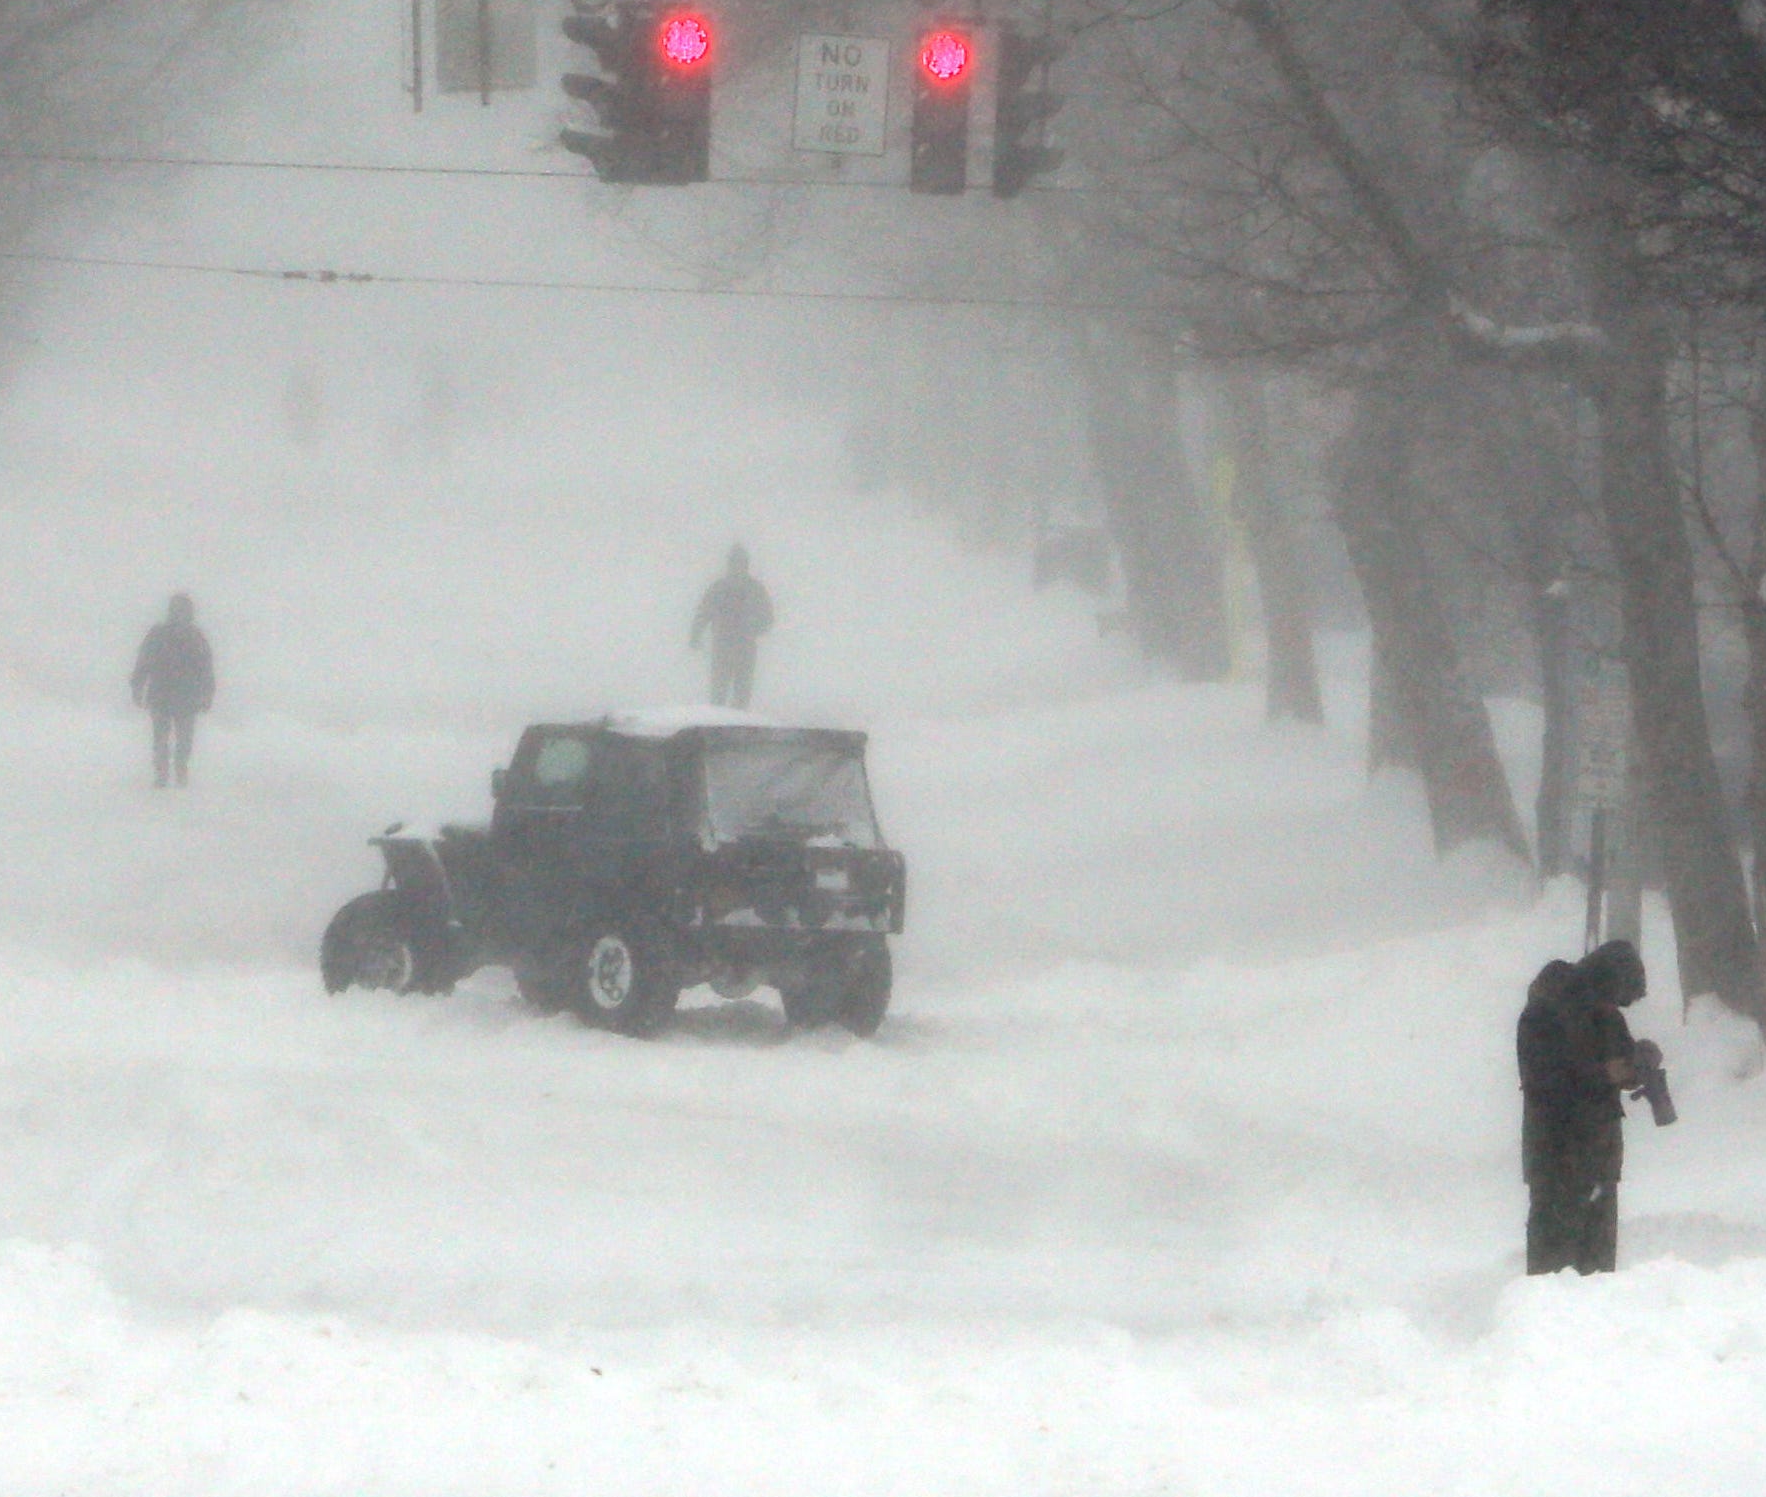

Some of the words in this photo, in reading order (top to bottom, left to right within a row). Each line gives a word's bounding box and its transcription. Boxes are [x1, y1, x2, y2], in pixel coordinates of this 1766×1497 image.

[821, 42, 862, 67] NO
[816, 73, 869, 92] TURN
[827, 99, 856, 118] ON
[820, 124, 859, 143] RED
